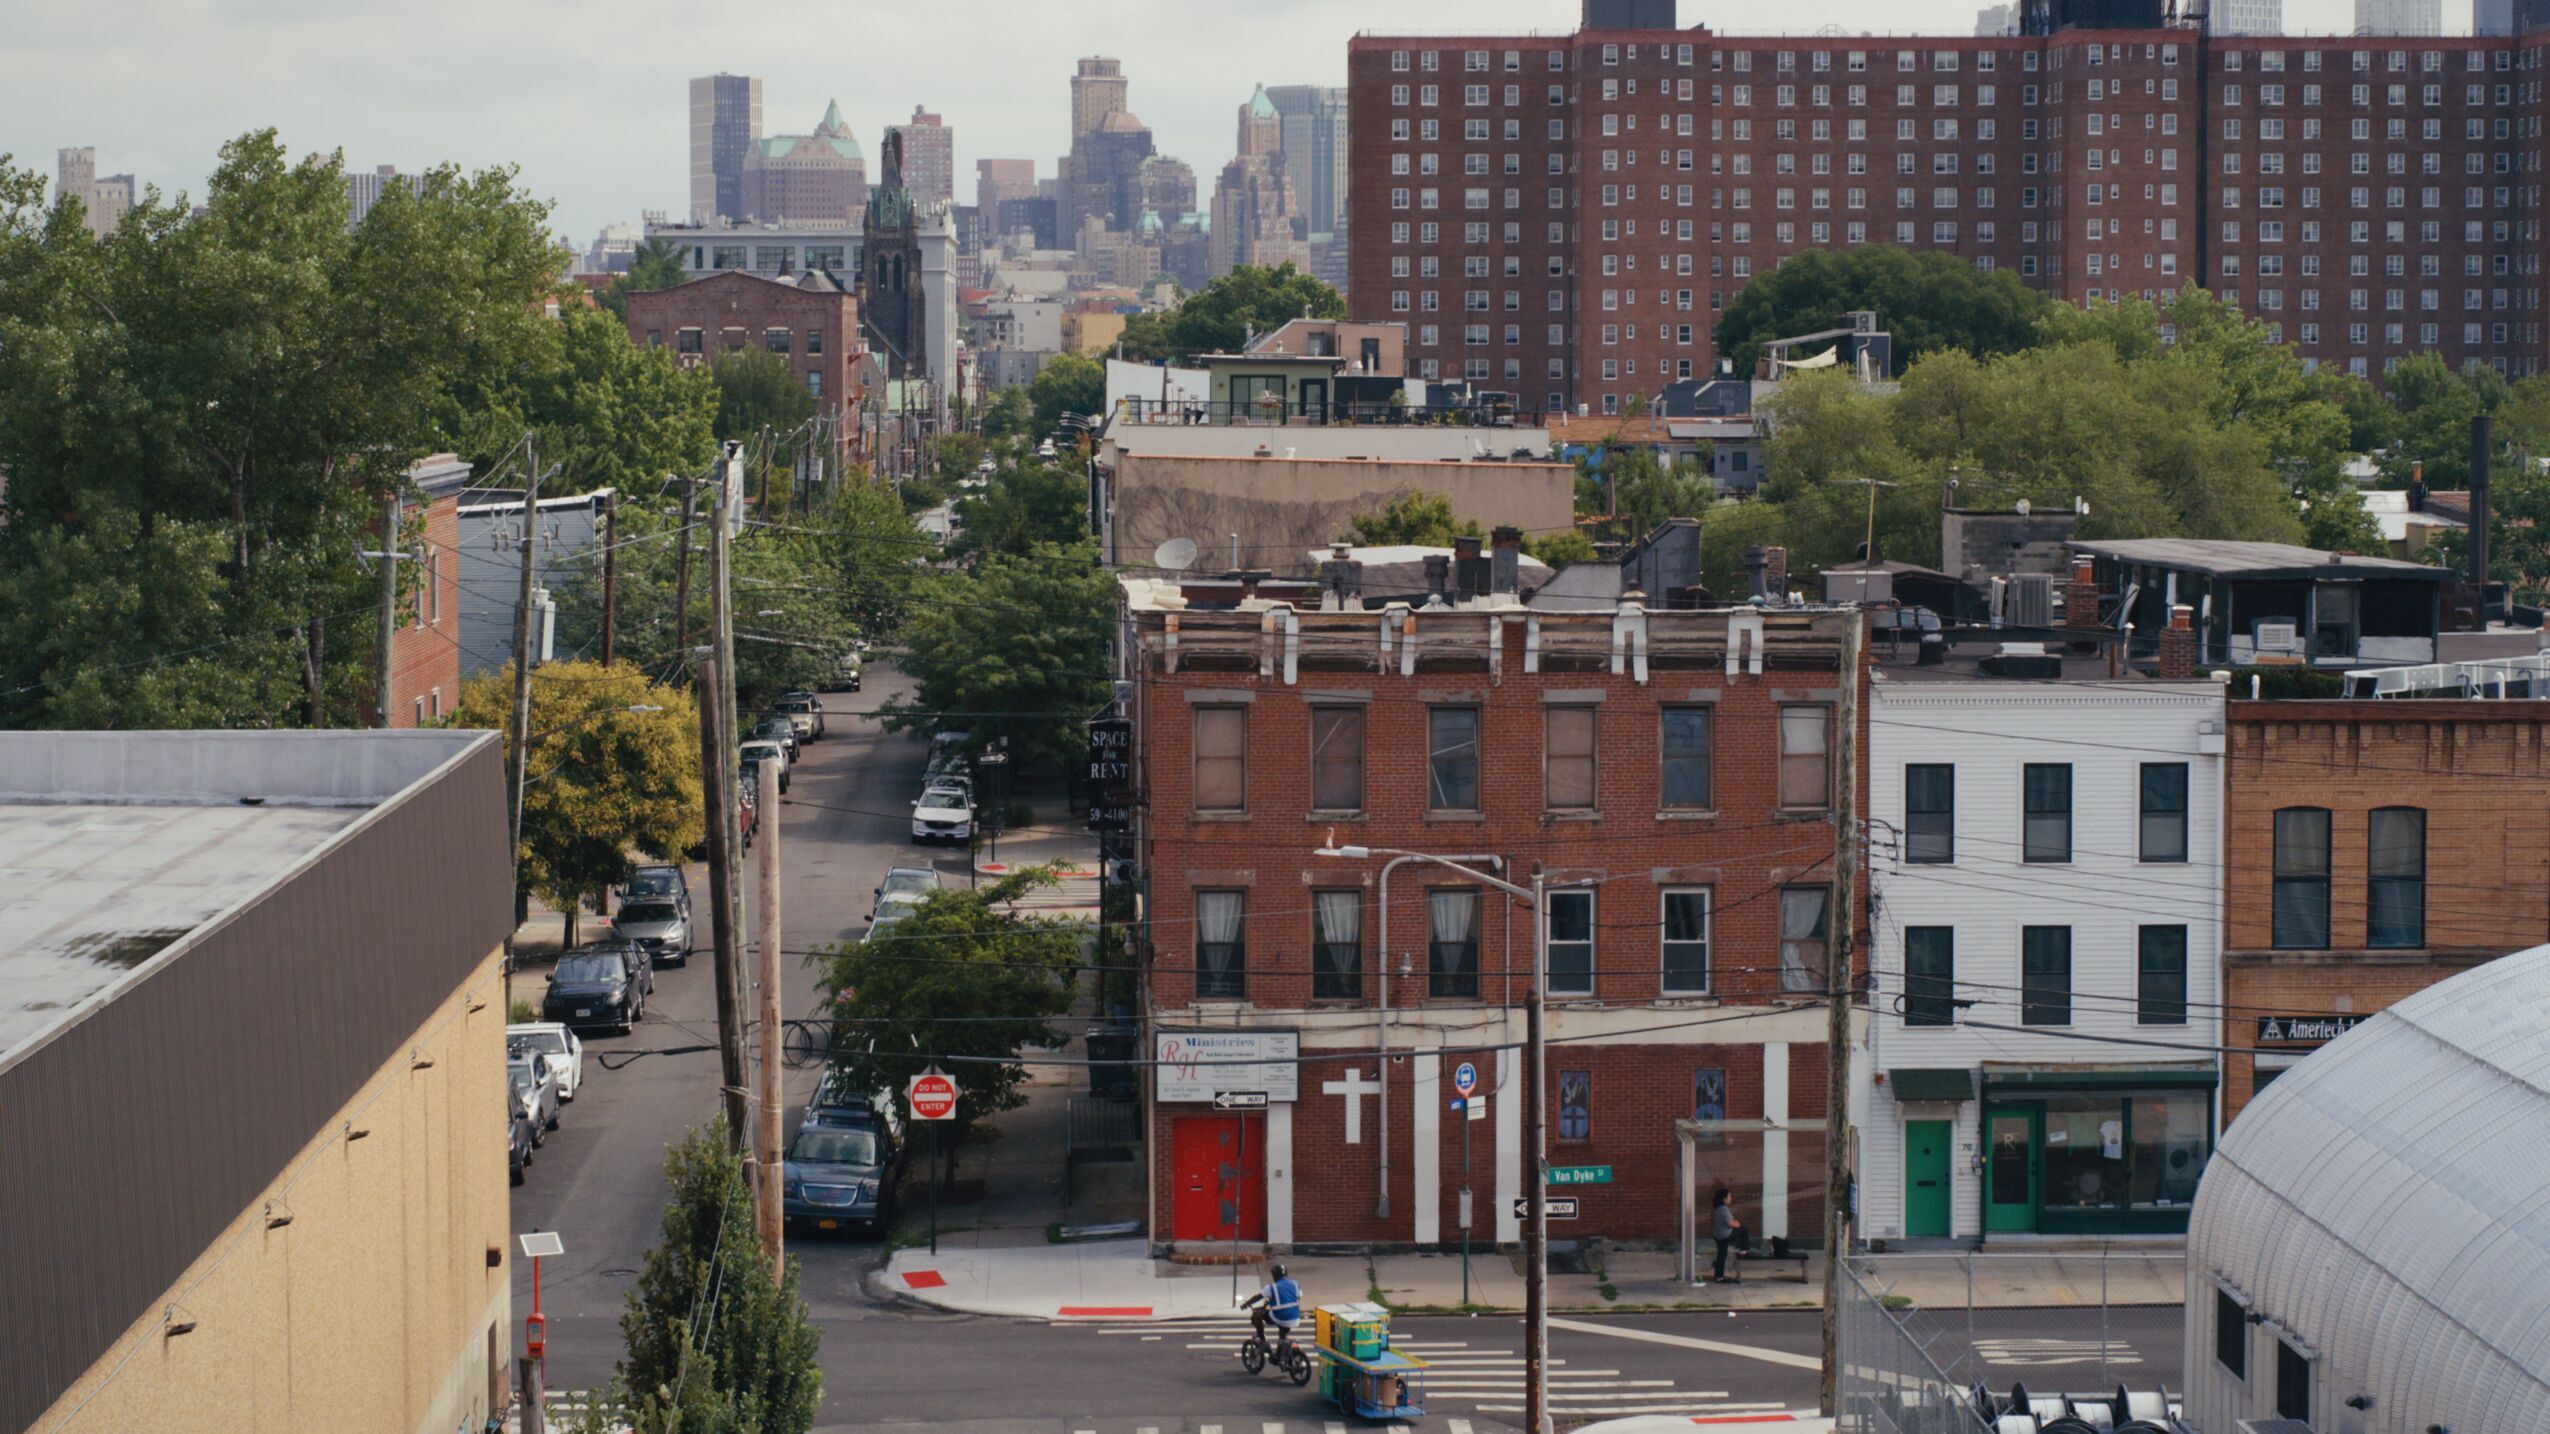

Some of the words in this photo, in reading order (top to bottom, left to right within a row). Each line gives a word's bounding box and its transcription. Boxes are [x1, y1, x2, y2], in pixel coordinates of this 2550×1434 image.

[1091, 730, 1128, 747] SPACE
[1090, 763, 1128, 778] RENT
[1185, 1037, 1255, 1047] Ministries
[1220, 1096, 1237, 1104] ONE
[1247, 1096, 1264, 1104] WAY
[920, 1103, 945, 1111] ENTER
[1554, 1170, 1571, 1182] Van
[1573, 1169, 1595, 1183] Dyke
[1551, 1204, 1571, 1212] WAY
